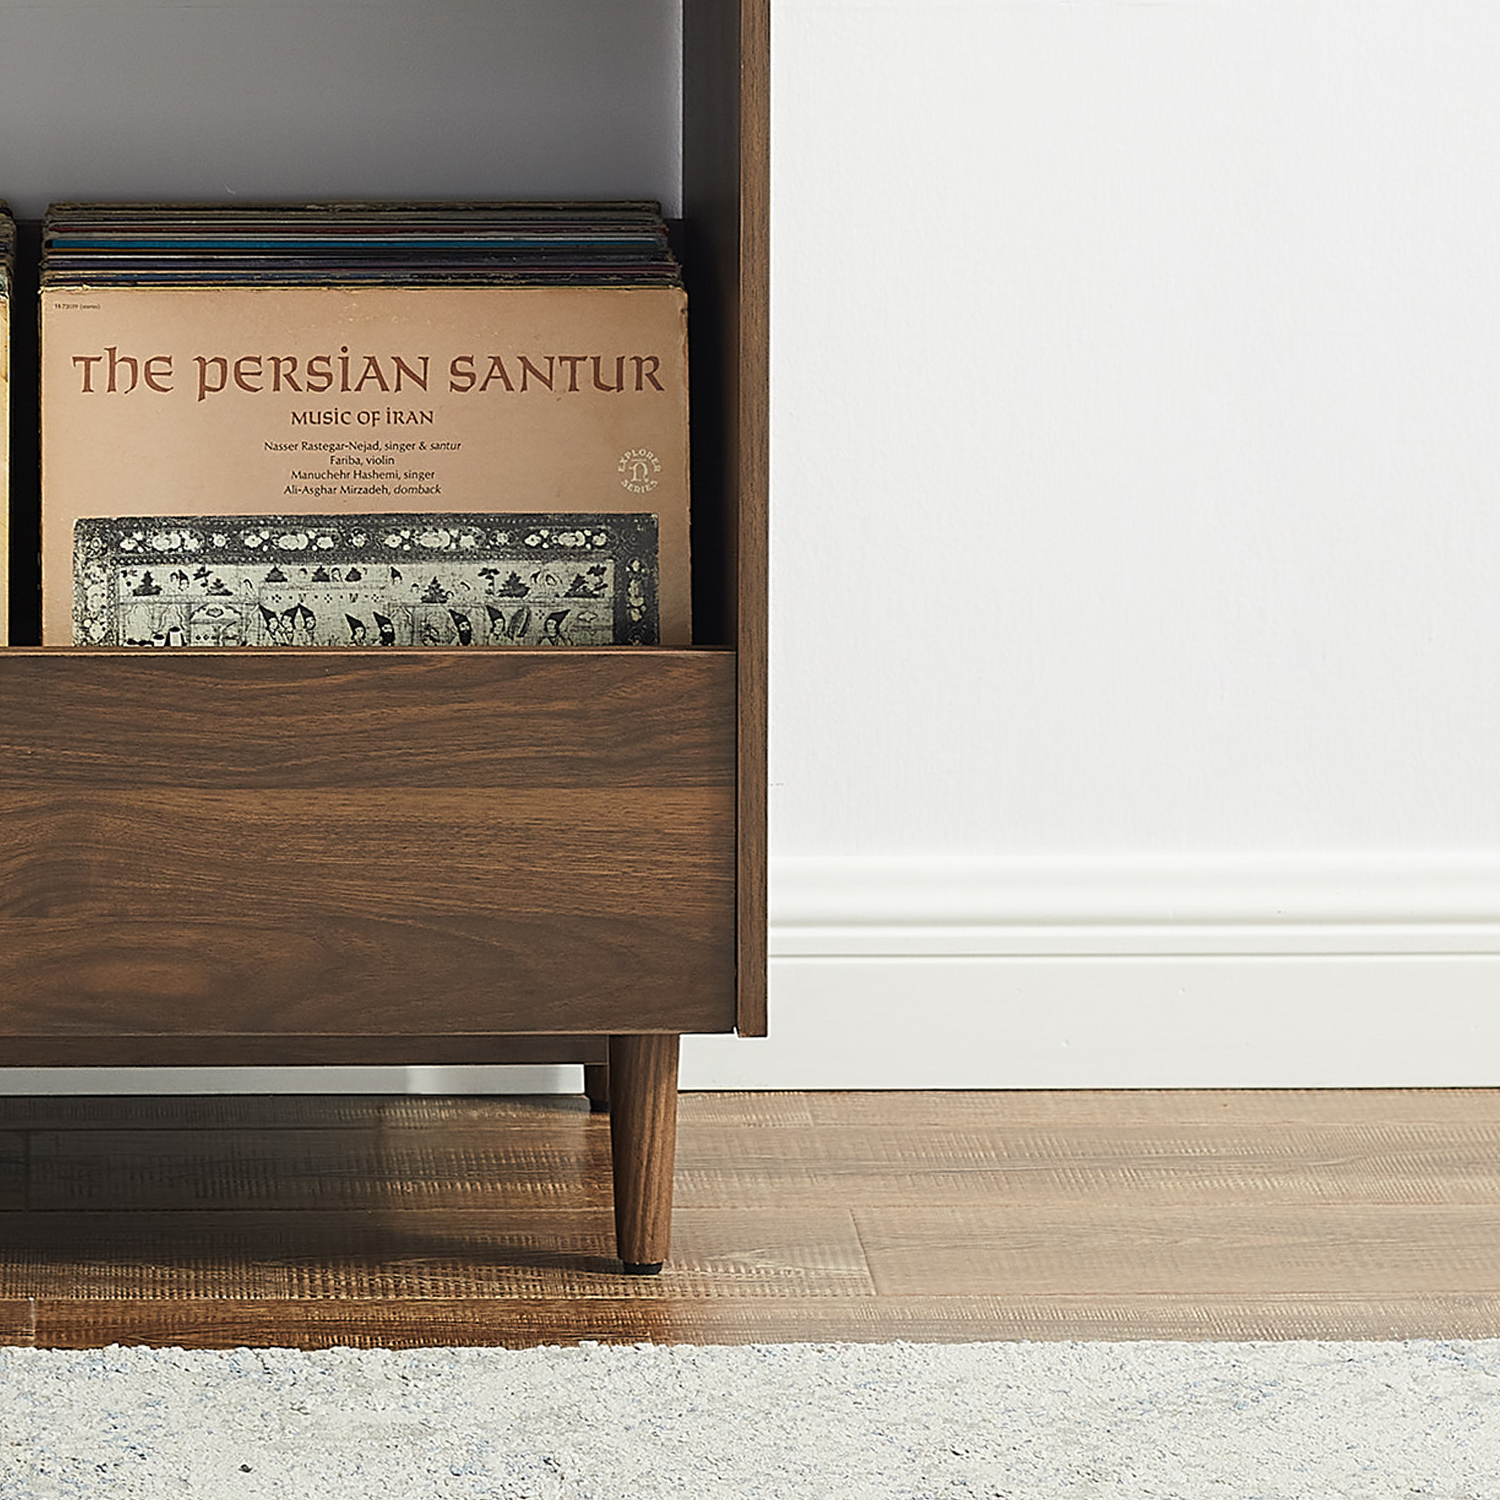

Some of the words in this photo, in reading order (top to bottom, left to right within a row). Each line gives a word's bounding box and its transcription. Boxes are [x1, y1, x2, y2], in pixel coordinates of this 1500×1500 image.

[450, 355, 665, 393] SANTUR
[357, 411, 380, 427] OF
[264, 442, 298, 450] Nasser
[302, 441, 382, 452] Rastegar-Nejad,
[385, 442, 415, 452] singer
[419, 442, 426, 450] &
[330, 456, 364, 466] Fariba,
[366, 456, 394, 465] violin
[618, 449, 660, 472] EXPLORER
[291, 470, 350, 479] Manuchehr
[354, 470, 401, 481] Hashemi,
[404, 471, 435, 481] singer
[284, 484, 336, 496] Ali-Asghar
[340, 484, 391, 495] Mirzadeh,
[394, 484, 441, 494] domback
[621, 480, 658, 493] SERIES
